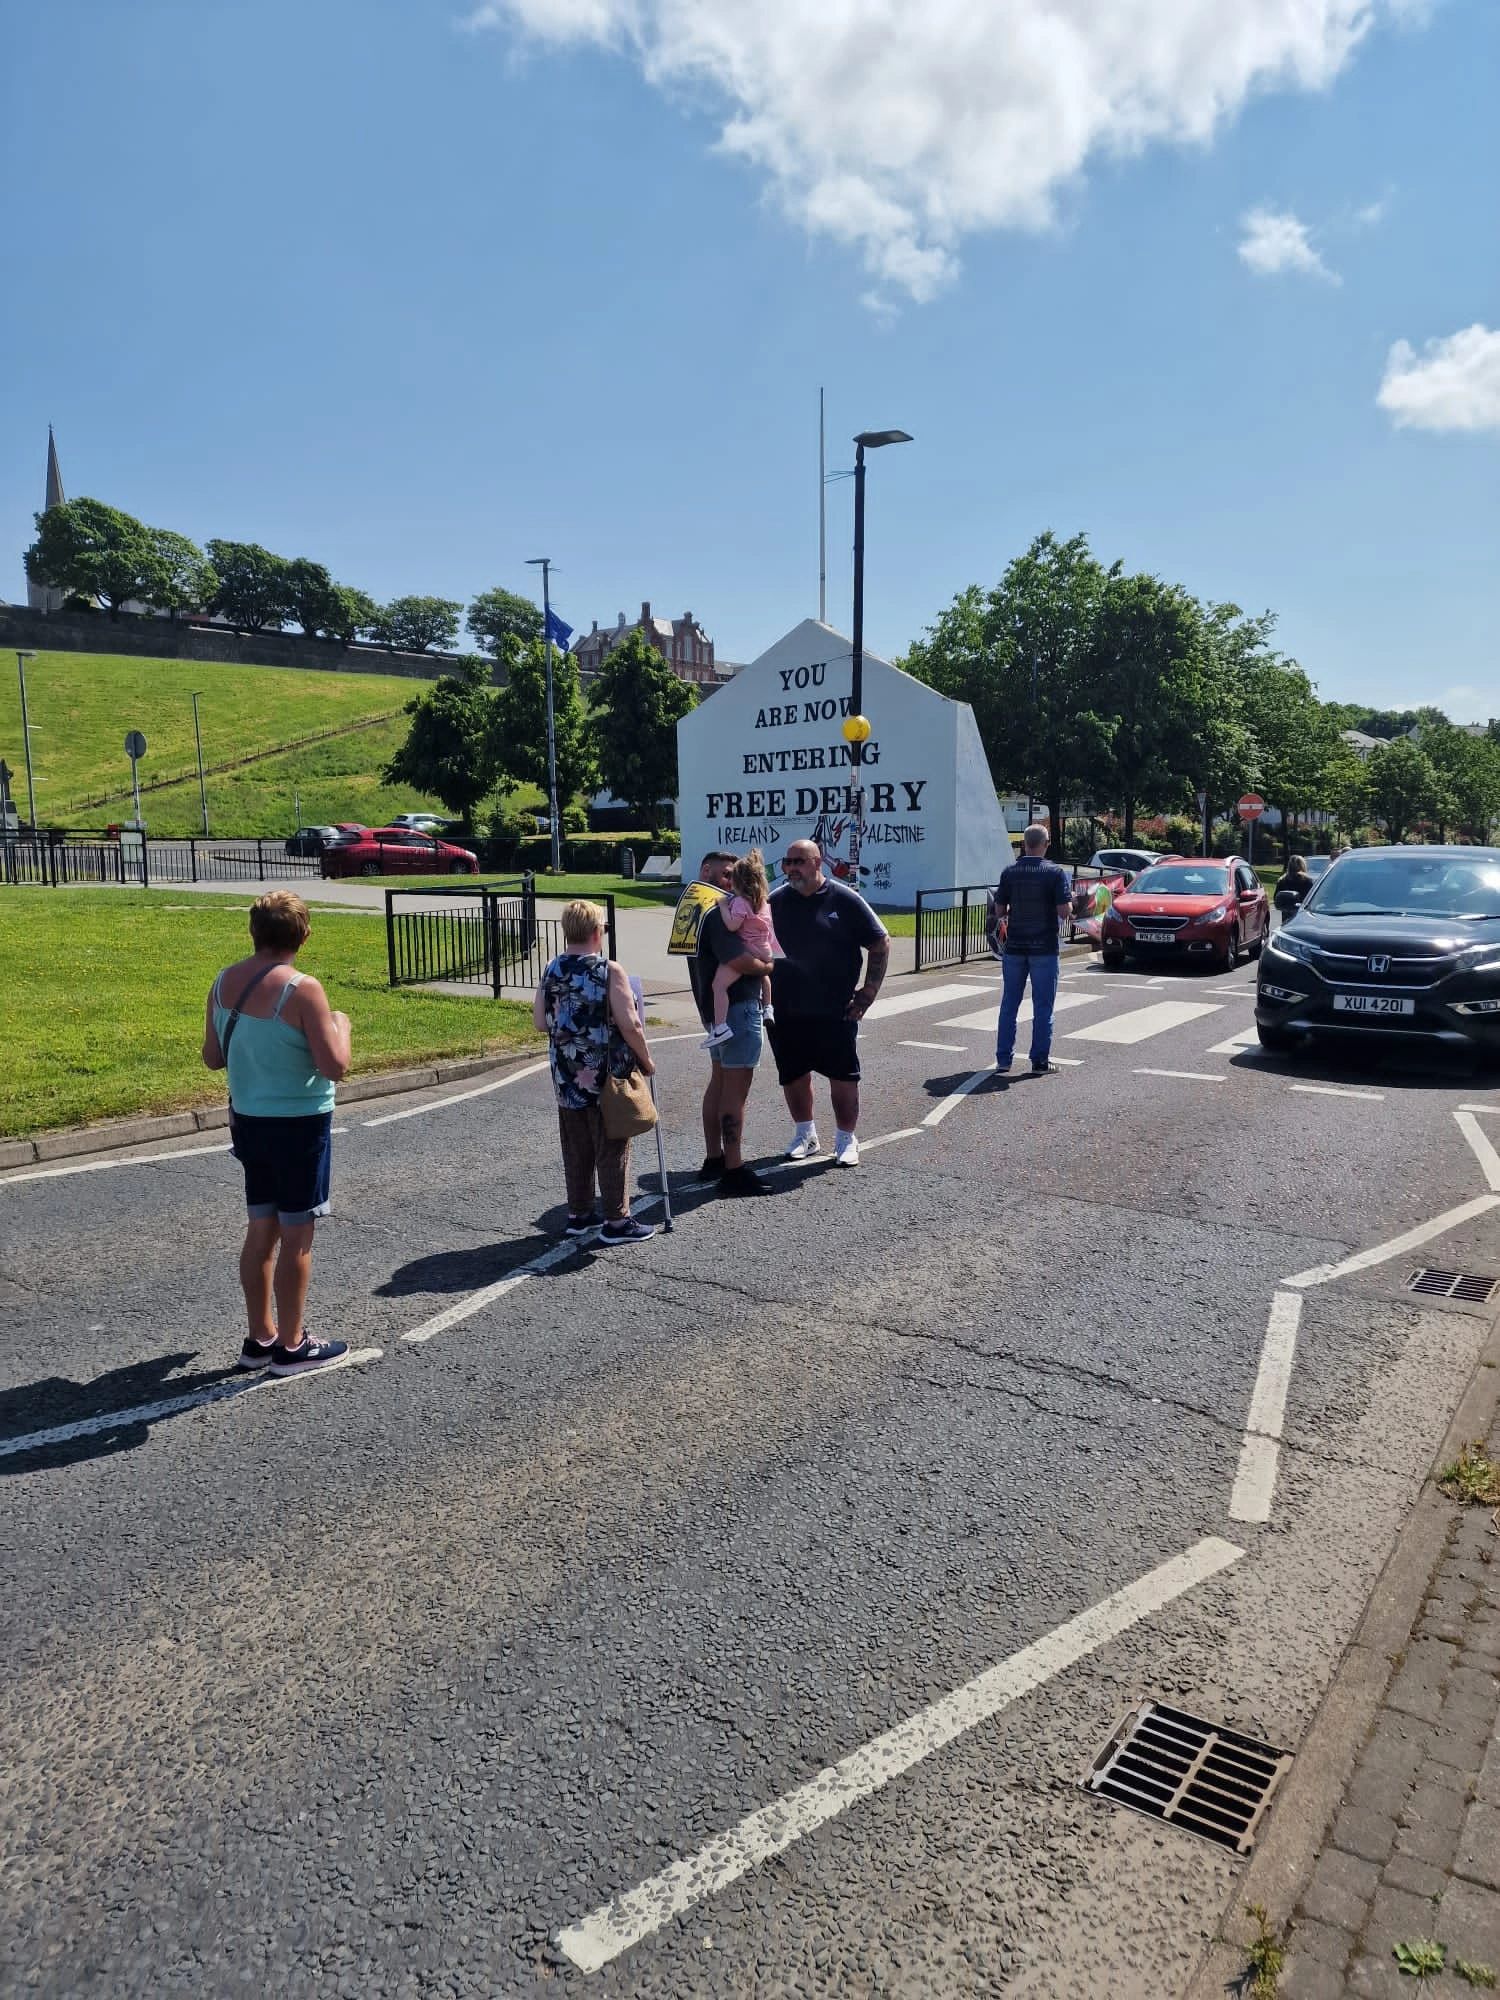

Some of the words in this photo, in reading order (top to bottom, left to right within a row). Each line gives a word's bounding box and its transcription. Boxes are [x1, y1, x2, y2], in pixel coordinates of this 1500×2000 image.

[779, 663, 827, 691] YOU
[755, 704, 798, 728] ARE
[743, 742, 880, 774] ENTERING
[706, 789, 786, 819] FREE
[718, 825, 780, 844] IRELAND
[1344, 996, 1367, 1009] XUI
[1370, 999, 1404, 1012] 4201
